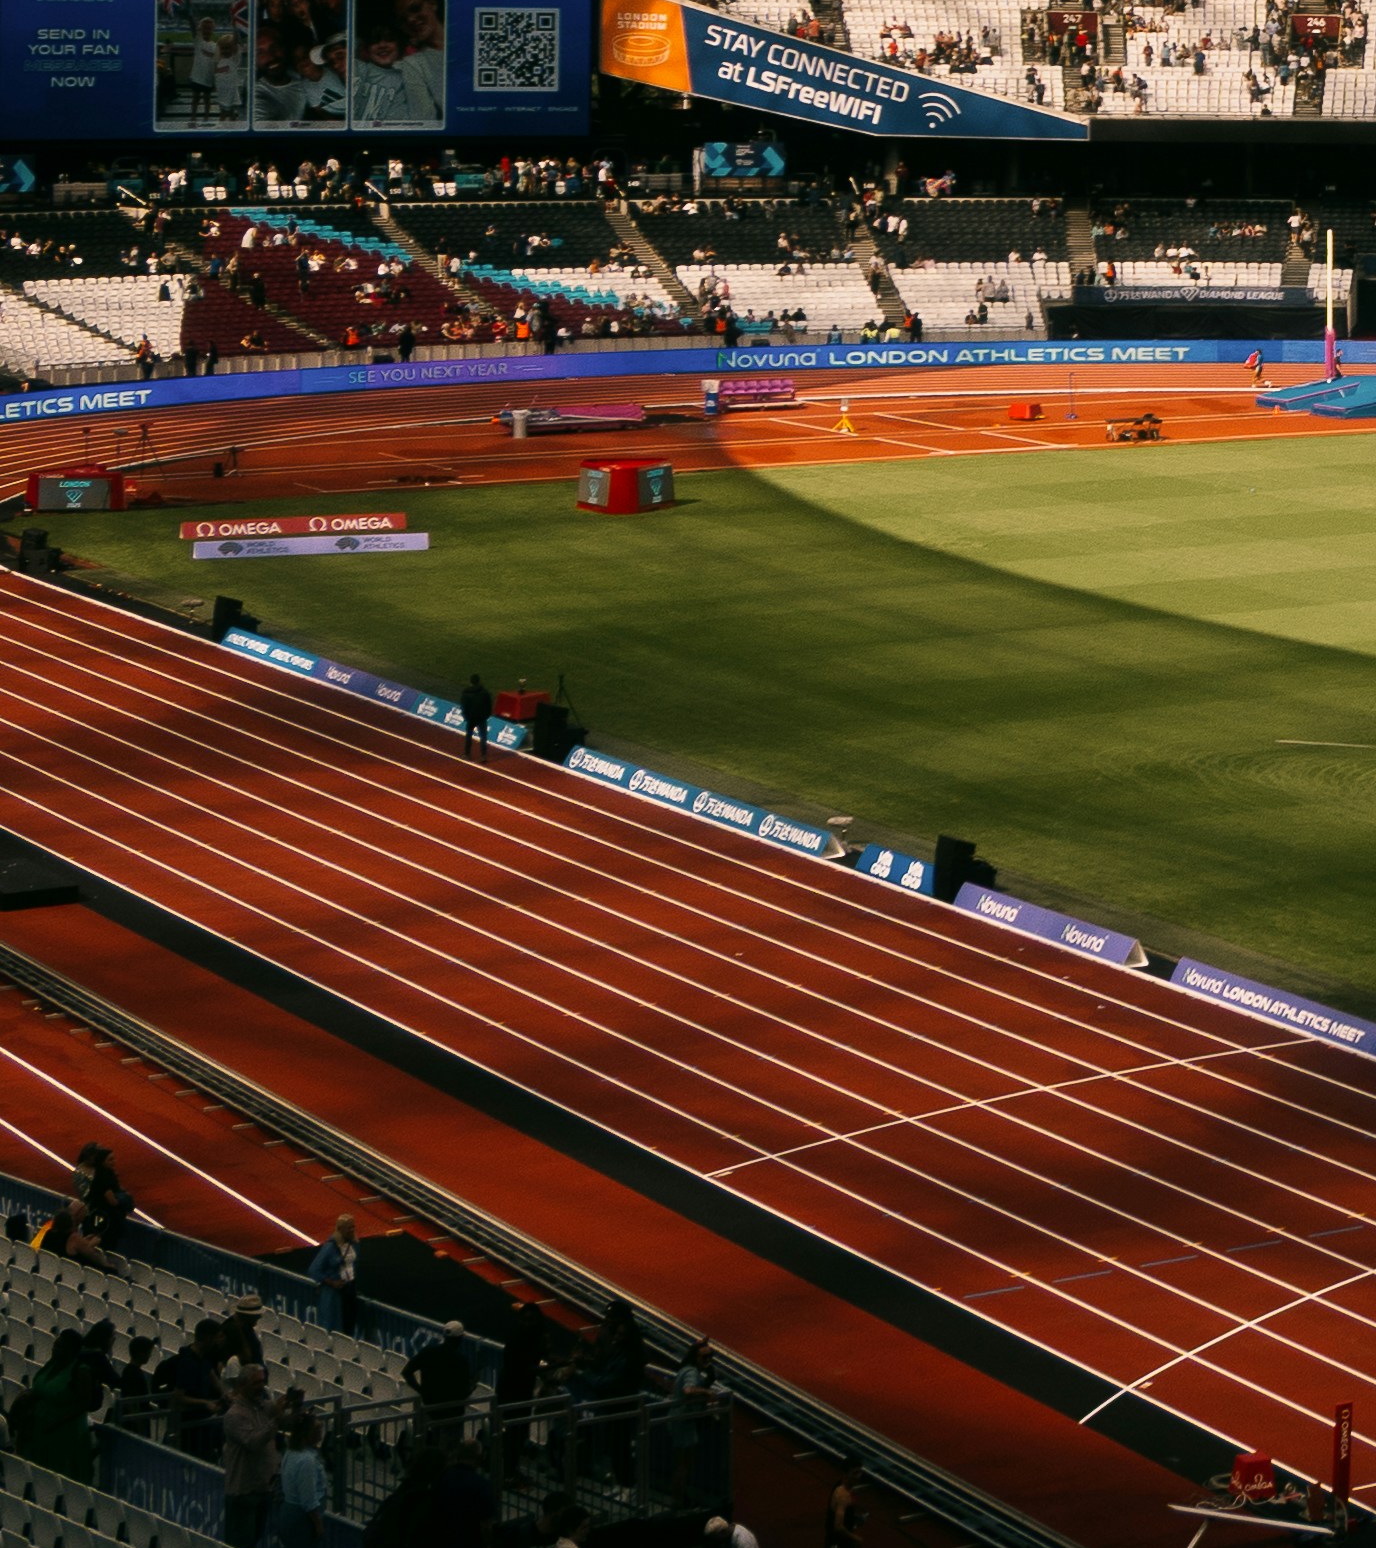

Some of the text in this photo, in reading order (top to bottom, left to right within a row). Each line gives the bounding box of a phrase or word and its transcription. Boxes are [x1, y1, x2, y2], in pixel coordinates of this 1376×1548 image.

[617, 13, 667, 22] LONDON
[617, 21, 667, 30] STADIUM
[1063, 14, 1082, 23] 247
[1307, 18, 1326, 27] 246
[38, 29, 110, 40] SEND IN
[28, 45, 120, 55] YOUR FAN
[704, 25, 910, 103] STAY CONNECTED
[717, 61, 744, 83] at
[51, 76, 95, 87] NOW
[1142, 291, 1285, 301] WANDA DIAMOND LEAGUE
[717, 347, 1190, 368] Novuna LONDON ATHLETICS MEET
[348, 363, 508, 384] SEE YOU NEXT YEAR
[80, 390, 152, 411] MEET
[219, 522, 282, 535] OMEGA
[331, 517, 393, 531] OMEGA
[596, 759, 626, 781] WANDA
[658, 780, 689, 803] WANDA
[721, 801, 754, 826] WANDA
[788, 824, 822, 851] WANDA
[977, 894, 1018, 923] Novuna
[1062, 923, 1104, 953] Novuna
[1183, 967, 1365, 1045] Novuna LONDON ATHLETICS MEET
